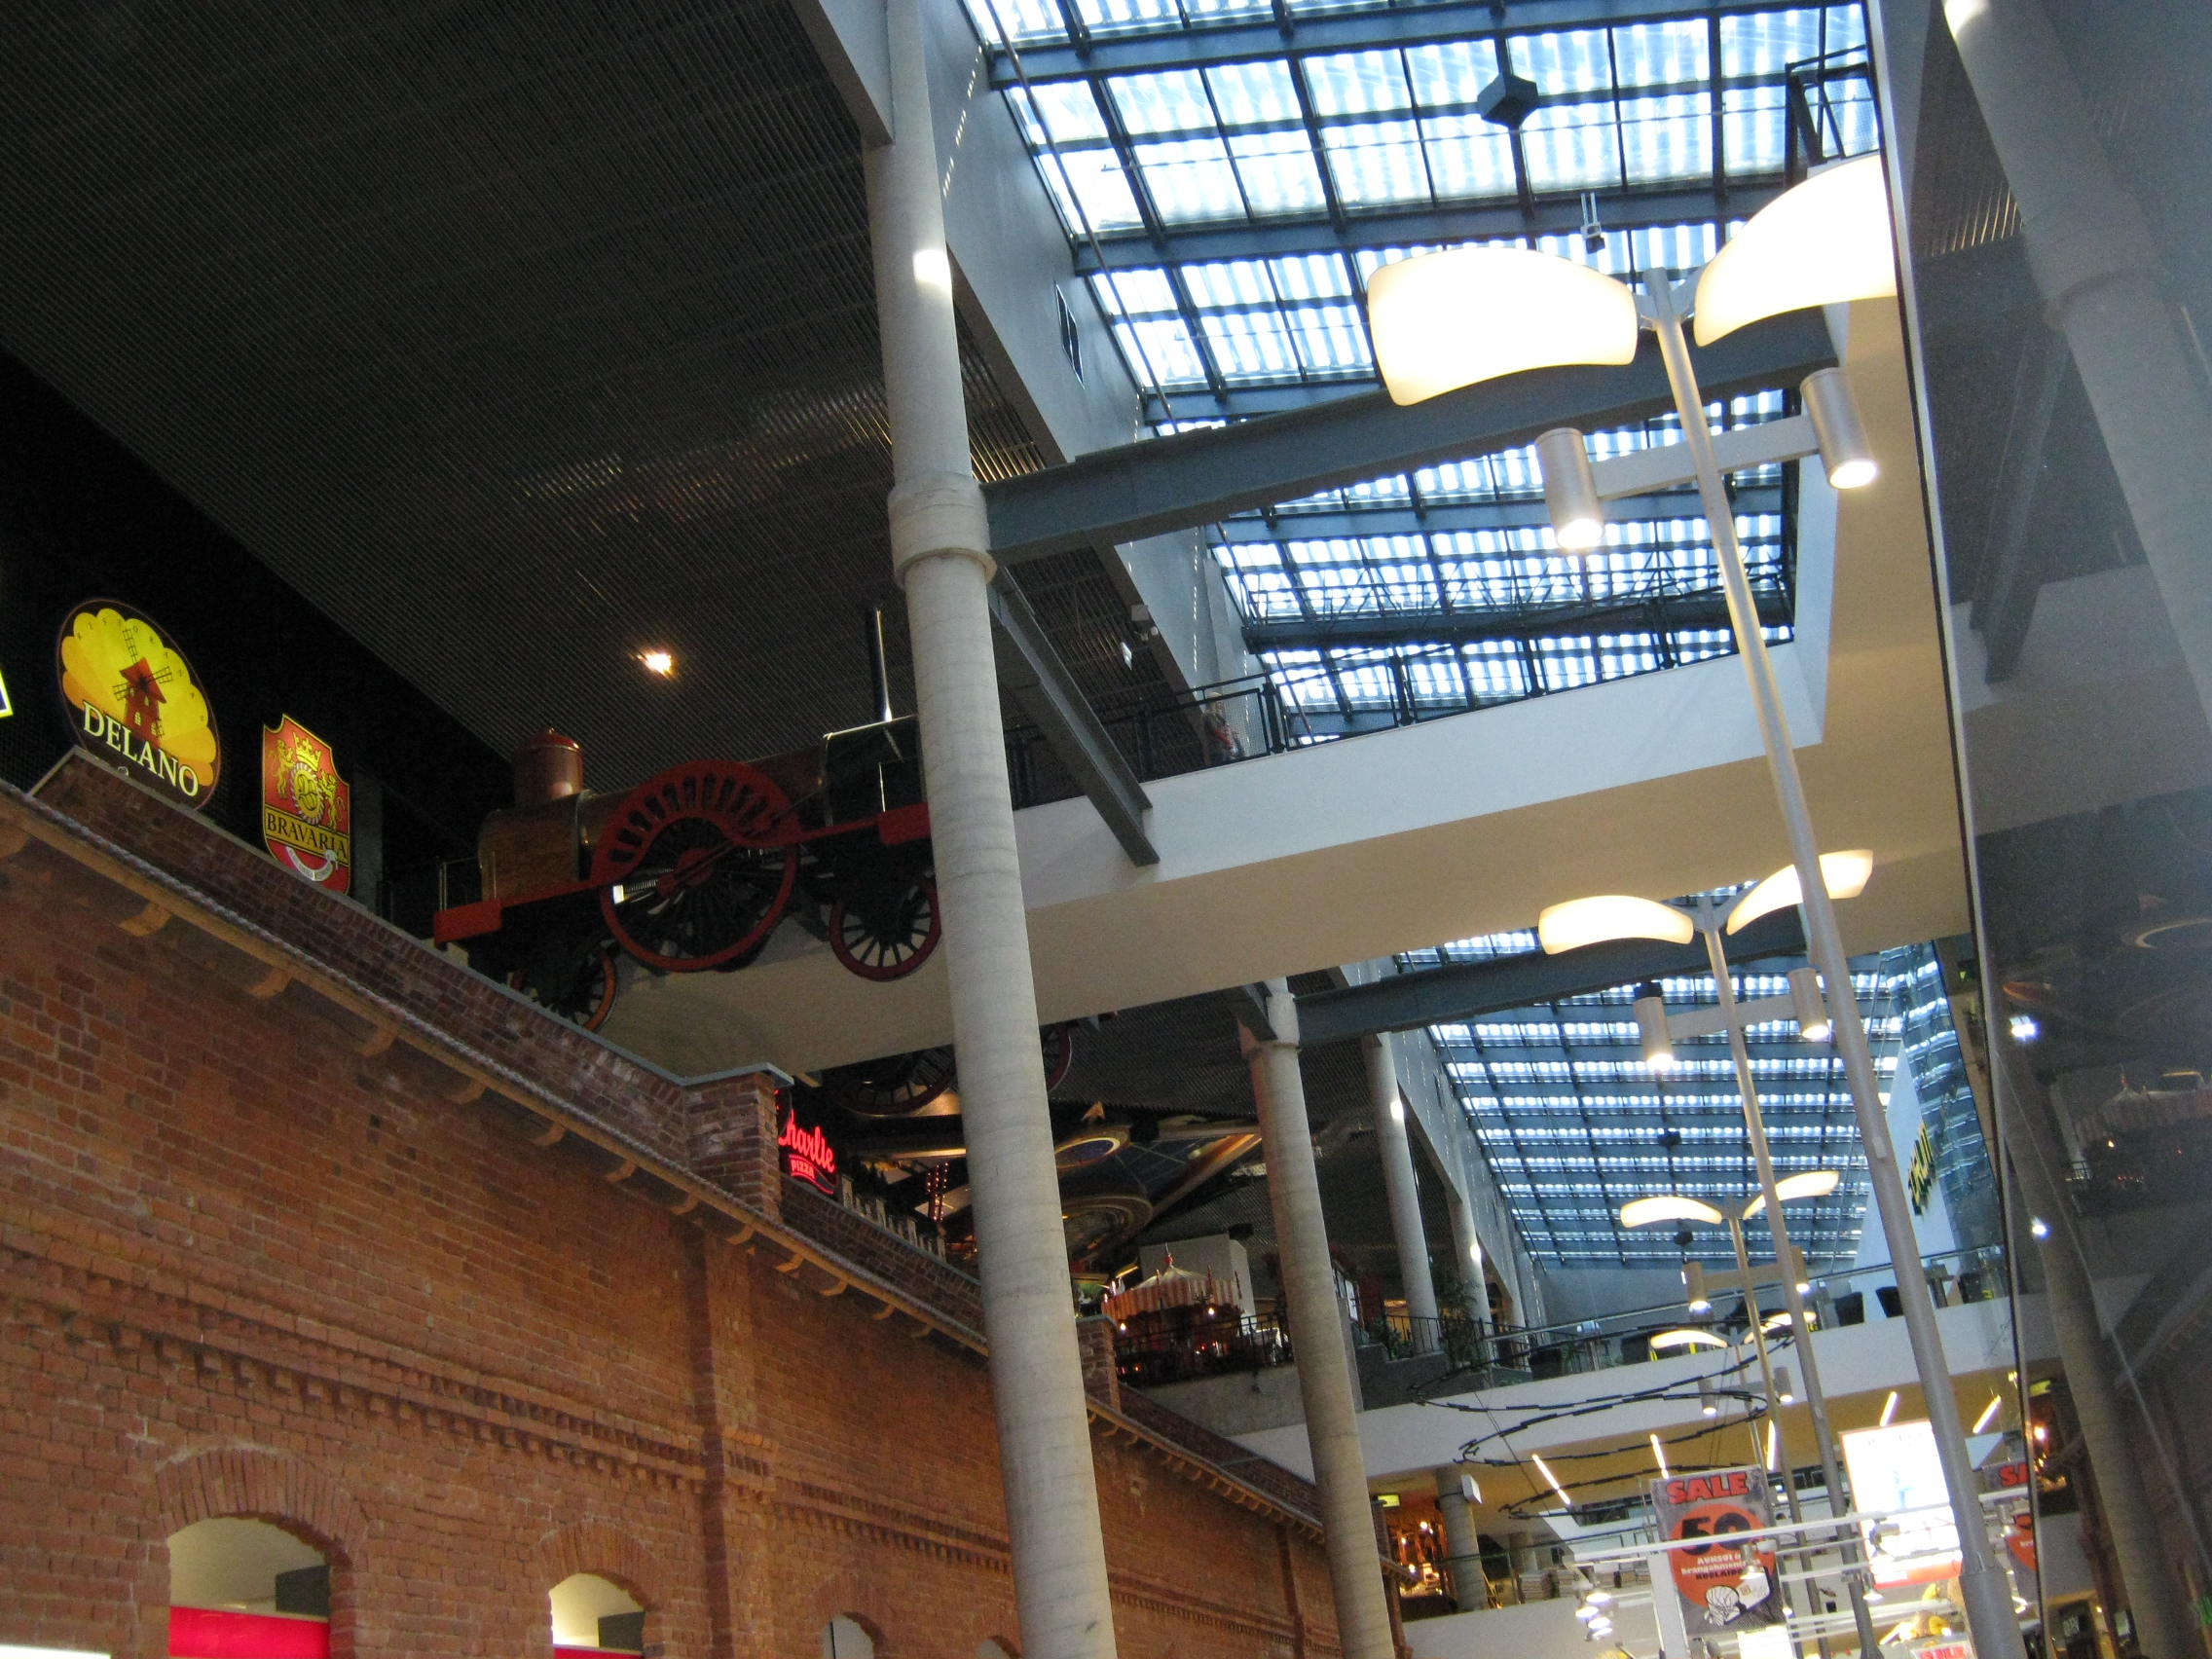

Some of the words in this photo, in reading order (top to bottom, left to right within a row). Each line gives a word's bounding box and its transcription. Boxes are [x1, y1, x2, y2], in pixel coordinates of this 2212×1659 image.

[82, 700, 200, 798] DELANO
[266, 812, 348, 859] BRAVARIA
[775, 1091, 836, 1174] harlie
[790, 1159, 816, 1180] PIZZA
[1666, 1470, 1751, 1505] SALE
